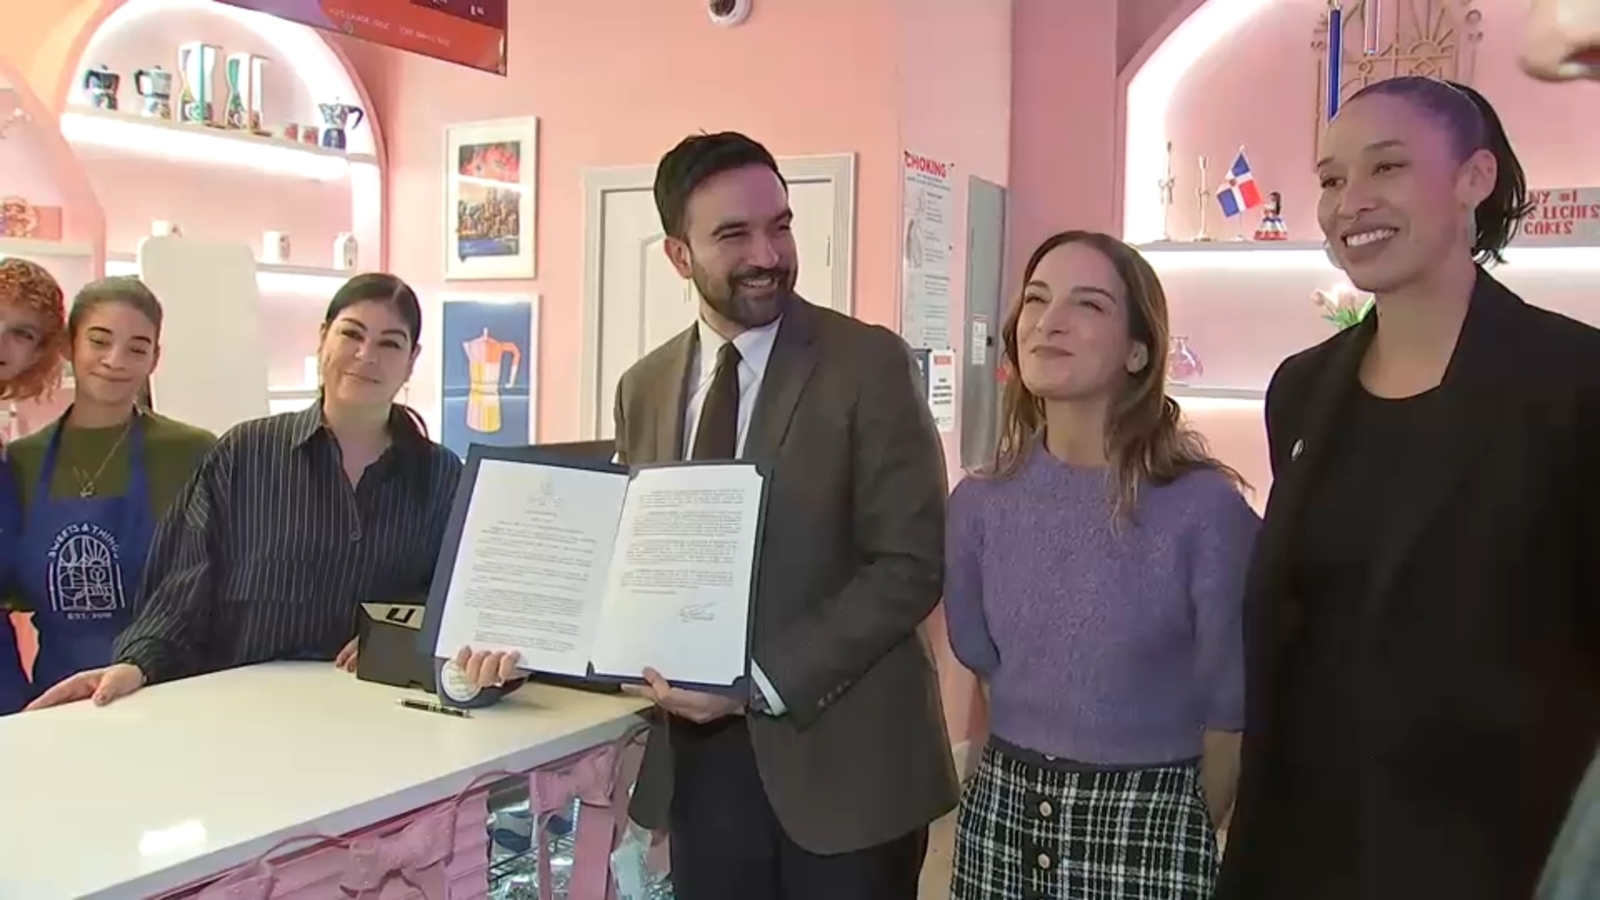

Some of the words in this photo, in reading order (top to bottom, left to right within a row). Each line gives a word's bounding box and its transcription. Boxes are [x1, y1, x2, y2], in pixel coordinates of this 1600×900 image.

[905, 155, 946, 177] CHOKING
[1529, 191, 1550, 204] NY
[1524, 221, 1573, 234] CAKES
